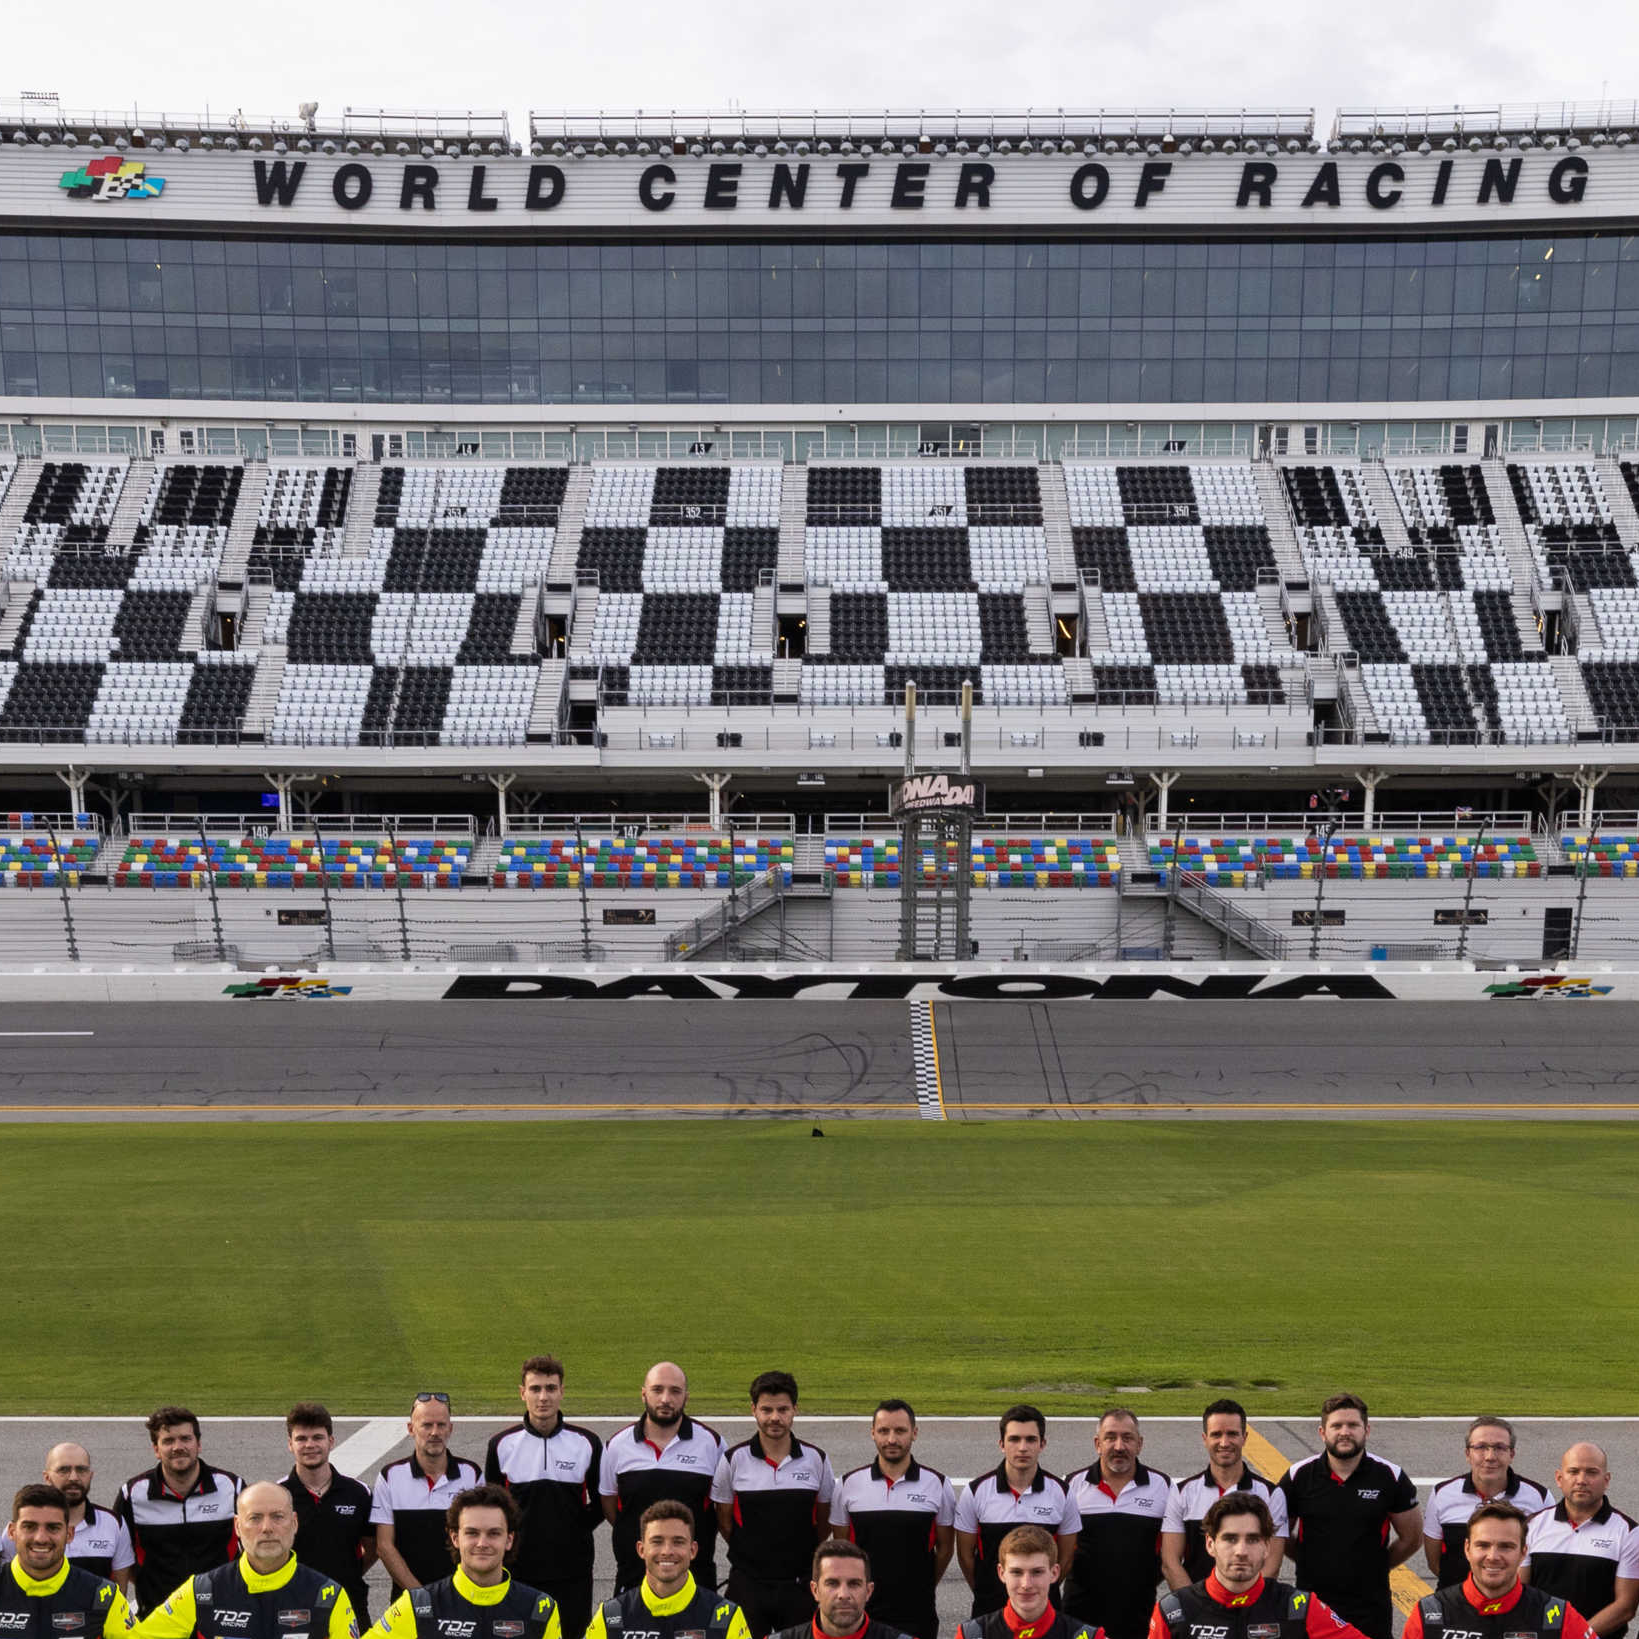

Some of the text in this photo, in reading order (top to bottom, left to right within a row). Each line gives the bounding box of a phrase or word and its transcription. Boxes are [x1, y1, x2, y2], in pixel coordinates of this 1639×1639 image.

[253, 155, 1589, 211] WORLD CENTER OF RACING
[685, 507, 701, 518] 352
[1173, 505, 1190, 517] 350
[251, 826, 269, 839] 148
[622, 825, 638, 838] 147
[442, 974, 1399, 999] DAYTONA
[213, 1609, 252, 1624] TDS
[438, 1618, 477, 1633] TDS
[1190, 1624, 1229, 1638] TDS
